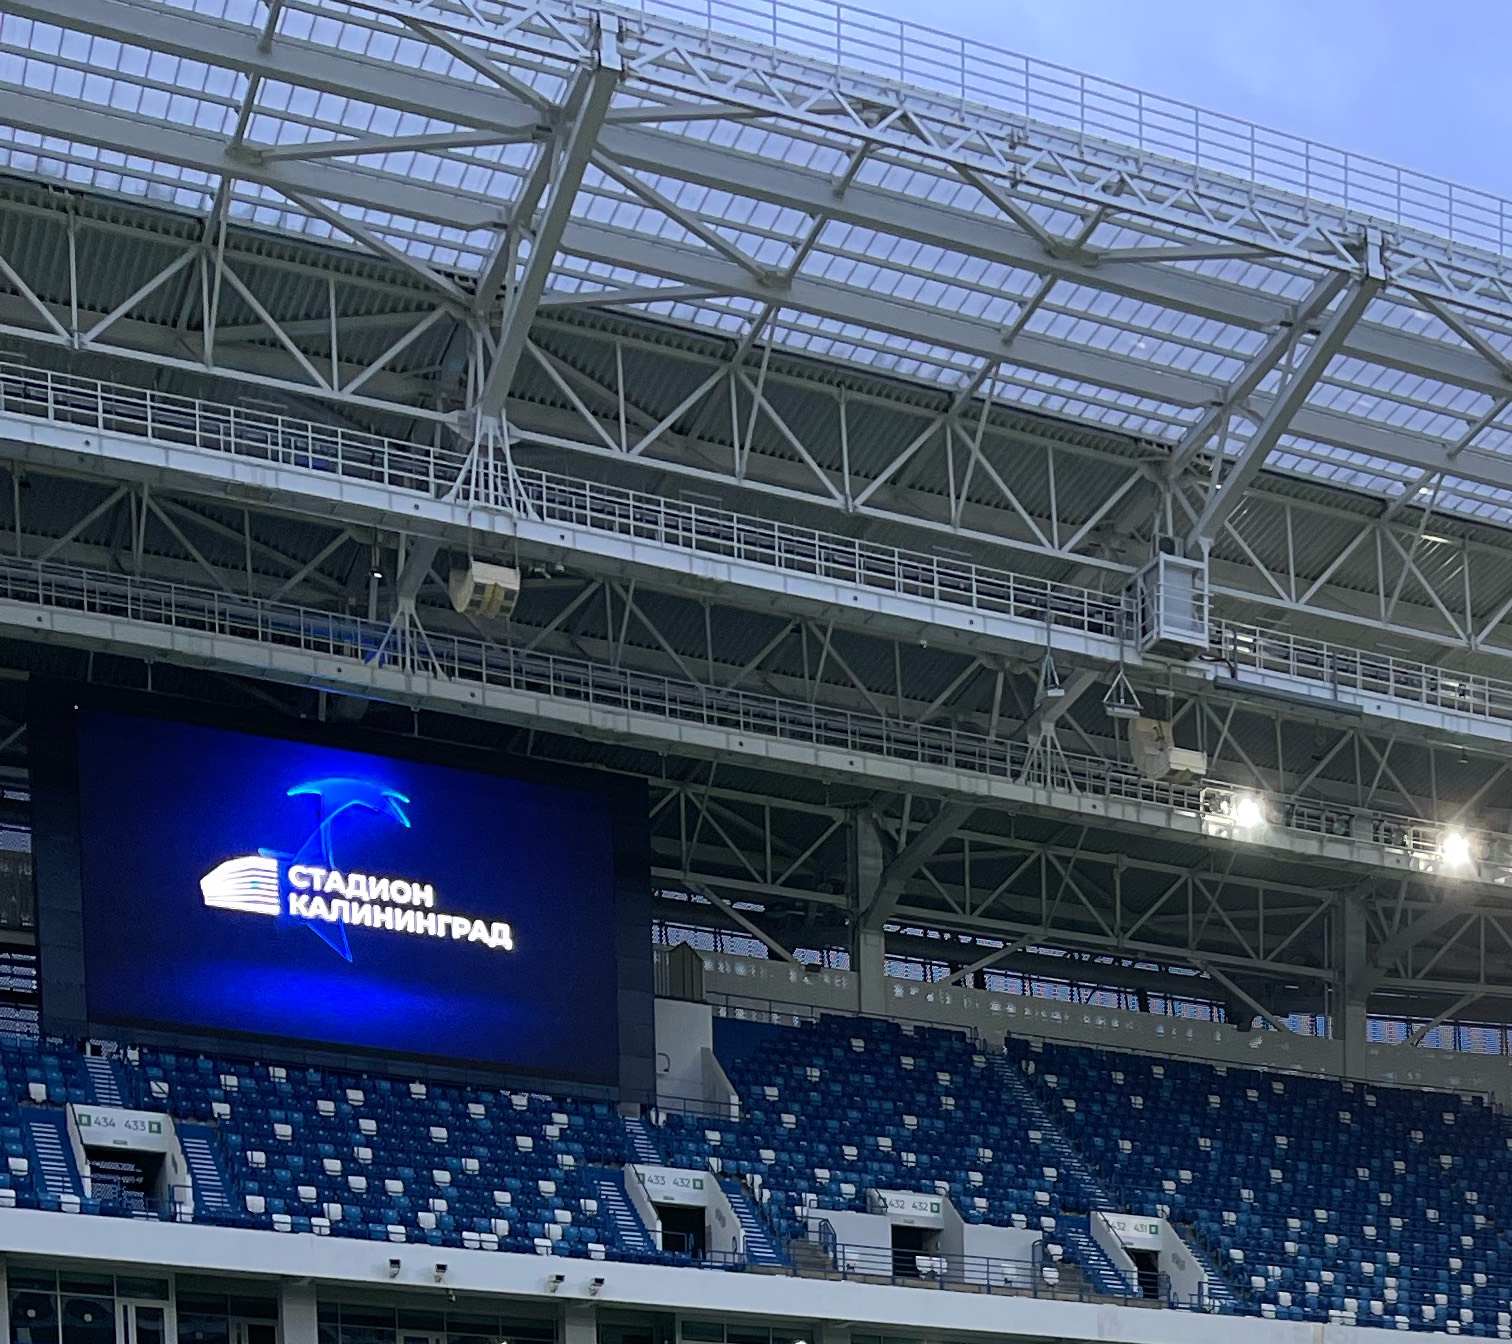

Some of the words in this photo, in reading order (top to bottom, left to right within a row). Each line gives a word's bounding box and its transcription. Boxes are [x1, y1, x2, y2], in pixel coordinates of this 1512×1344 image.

[287, 864, 435, 908] СТАДИОН
[288, 892, 514, 951] КАЛИНИНГРАД
[94, 1116, 116, 1129] 434
[124, 1119, 146, 1132] 433
[647, 1174, 666, 1186] 433
[672, 1177, 691, 1188] 432
[888, 1198, 905, 1210] 432
[911, 1201, 929, 1212] 432
